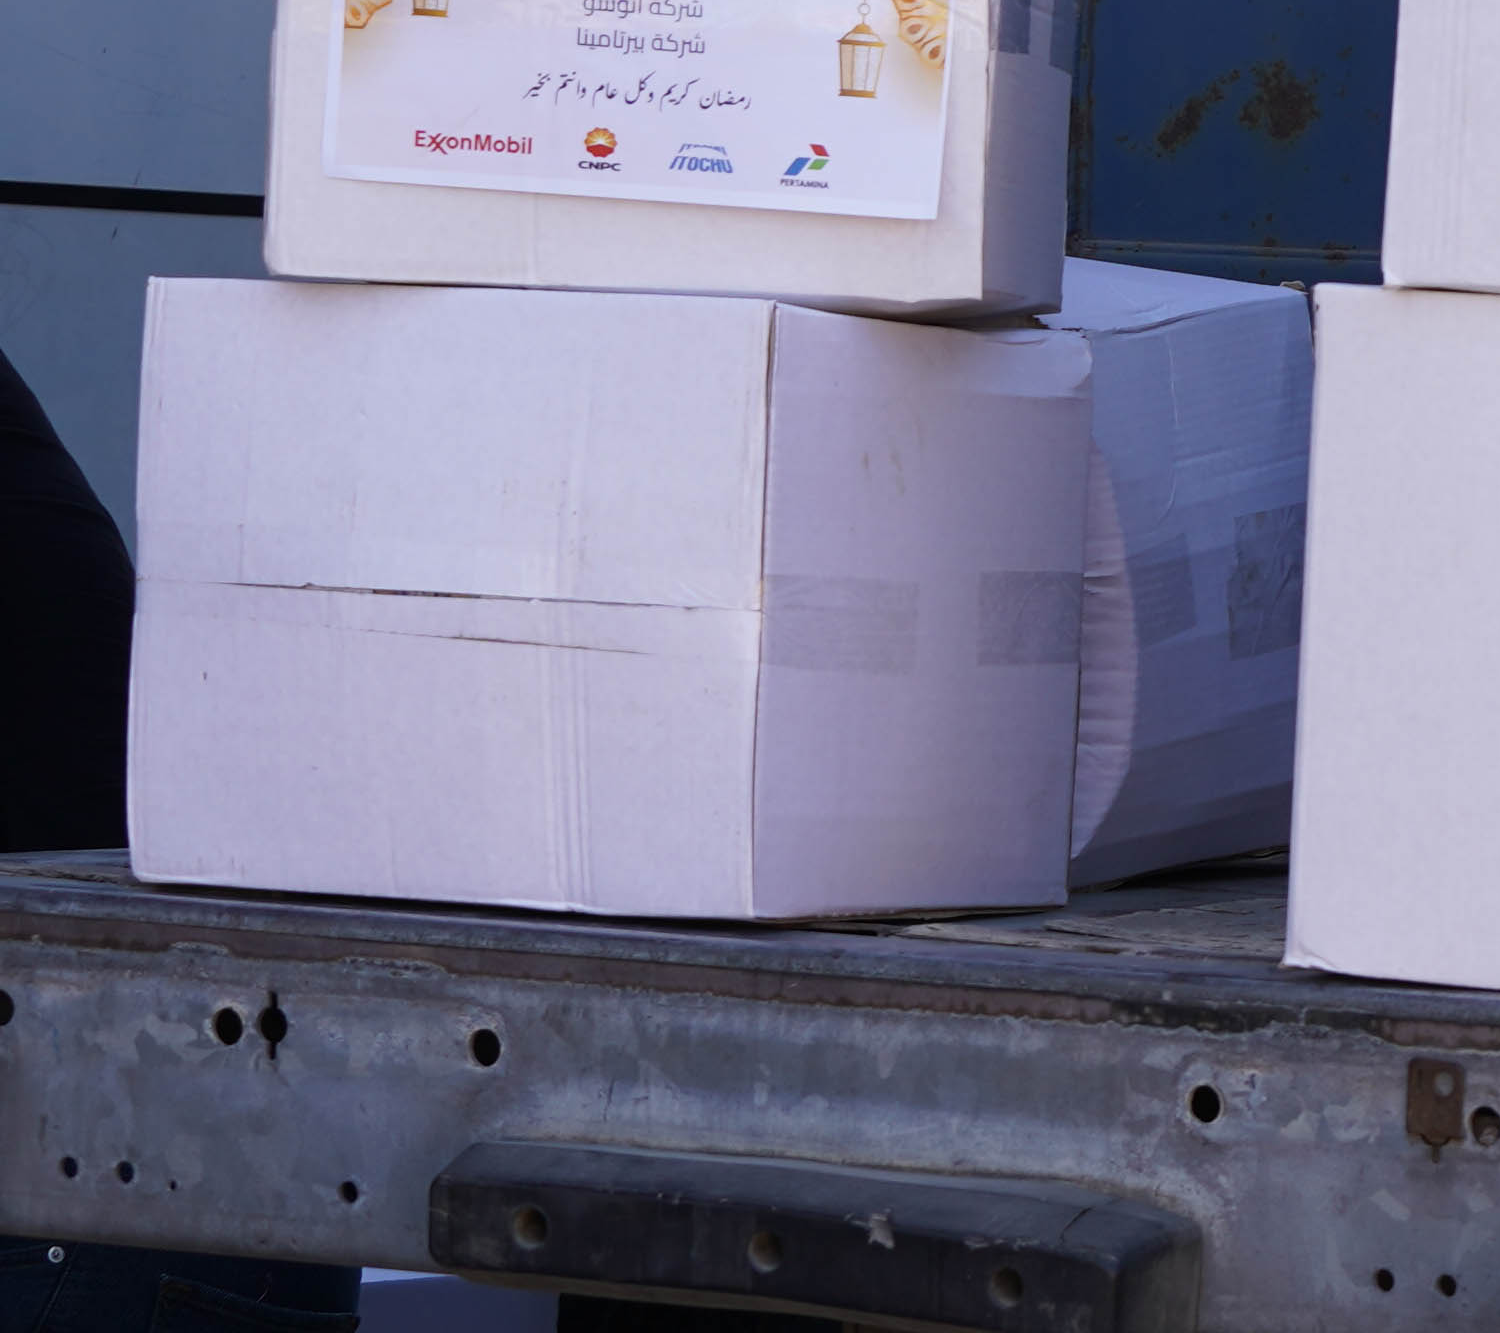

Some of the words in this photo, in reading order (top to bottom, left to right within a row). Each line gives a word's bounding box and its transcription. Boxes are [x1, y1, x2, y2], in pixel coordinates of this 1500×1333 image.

[652, 33, 705, 59] شركة
[592, 83, 618, 107] عام
[625, 71, 657, 104] وكل
[660, 78, 699, 111] كريم
[700, 90, 751, 111] رمضان
[414, 130, 533, 155] ExxonMobil
[578, 160, 621, 172] CNPC
[669, 155, 734, 174] ITOCHU
[779, 178, 830, 189] PERTAMINA
